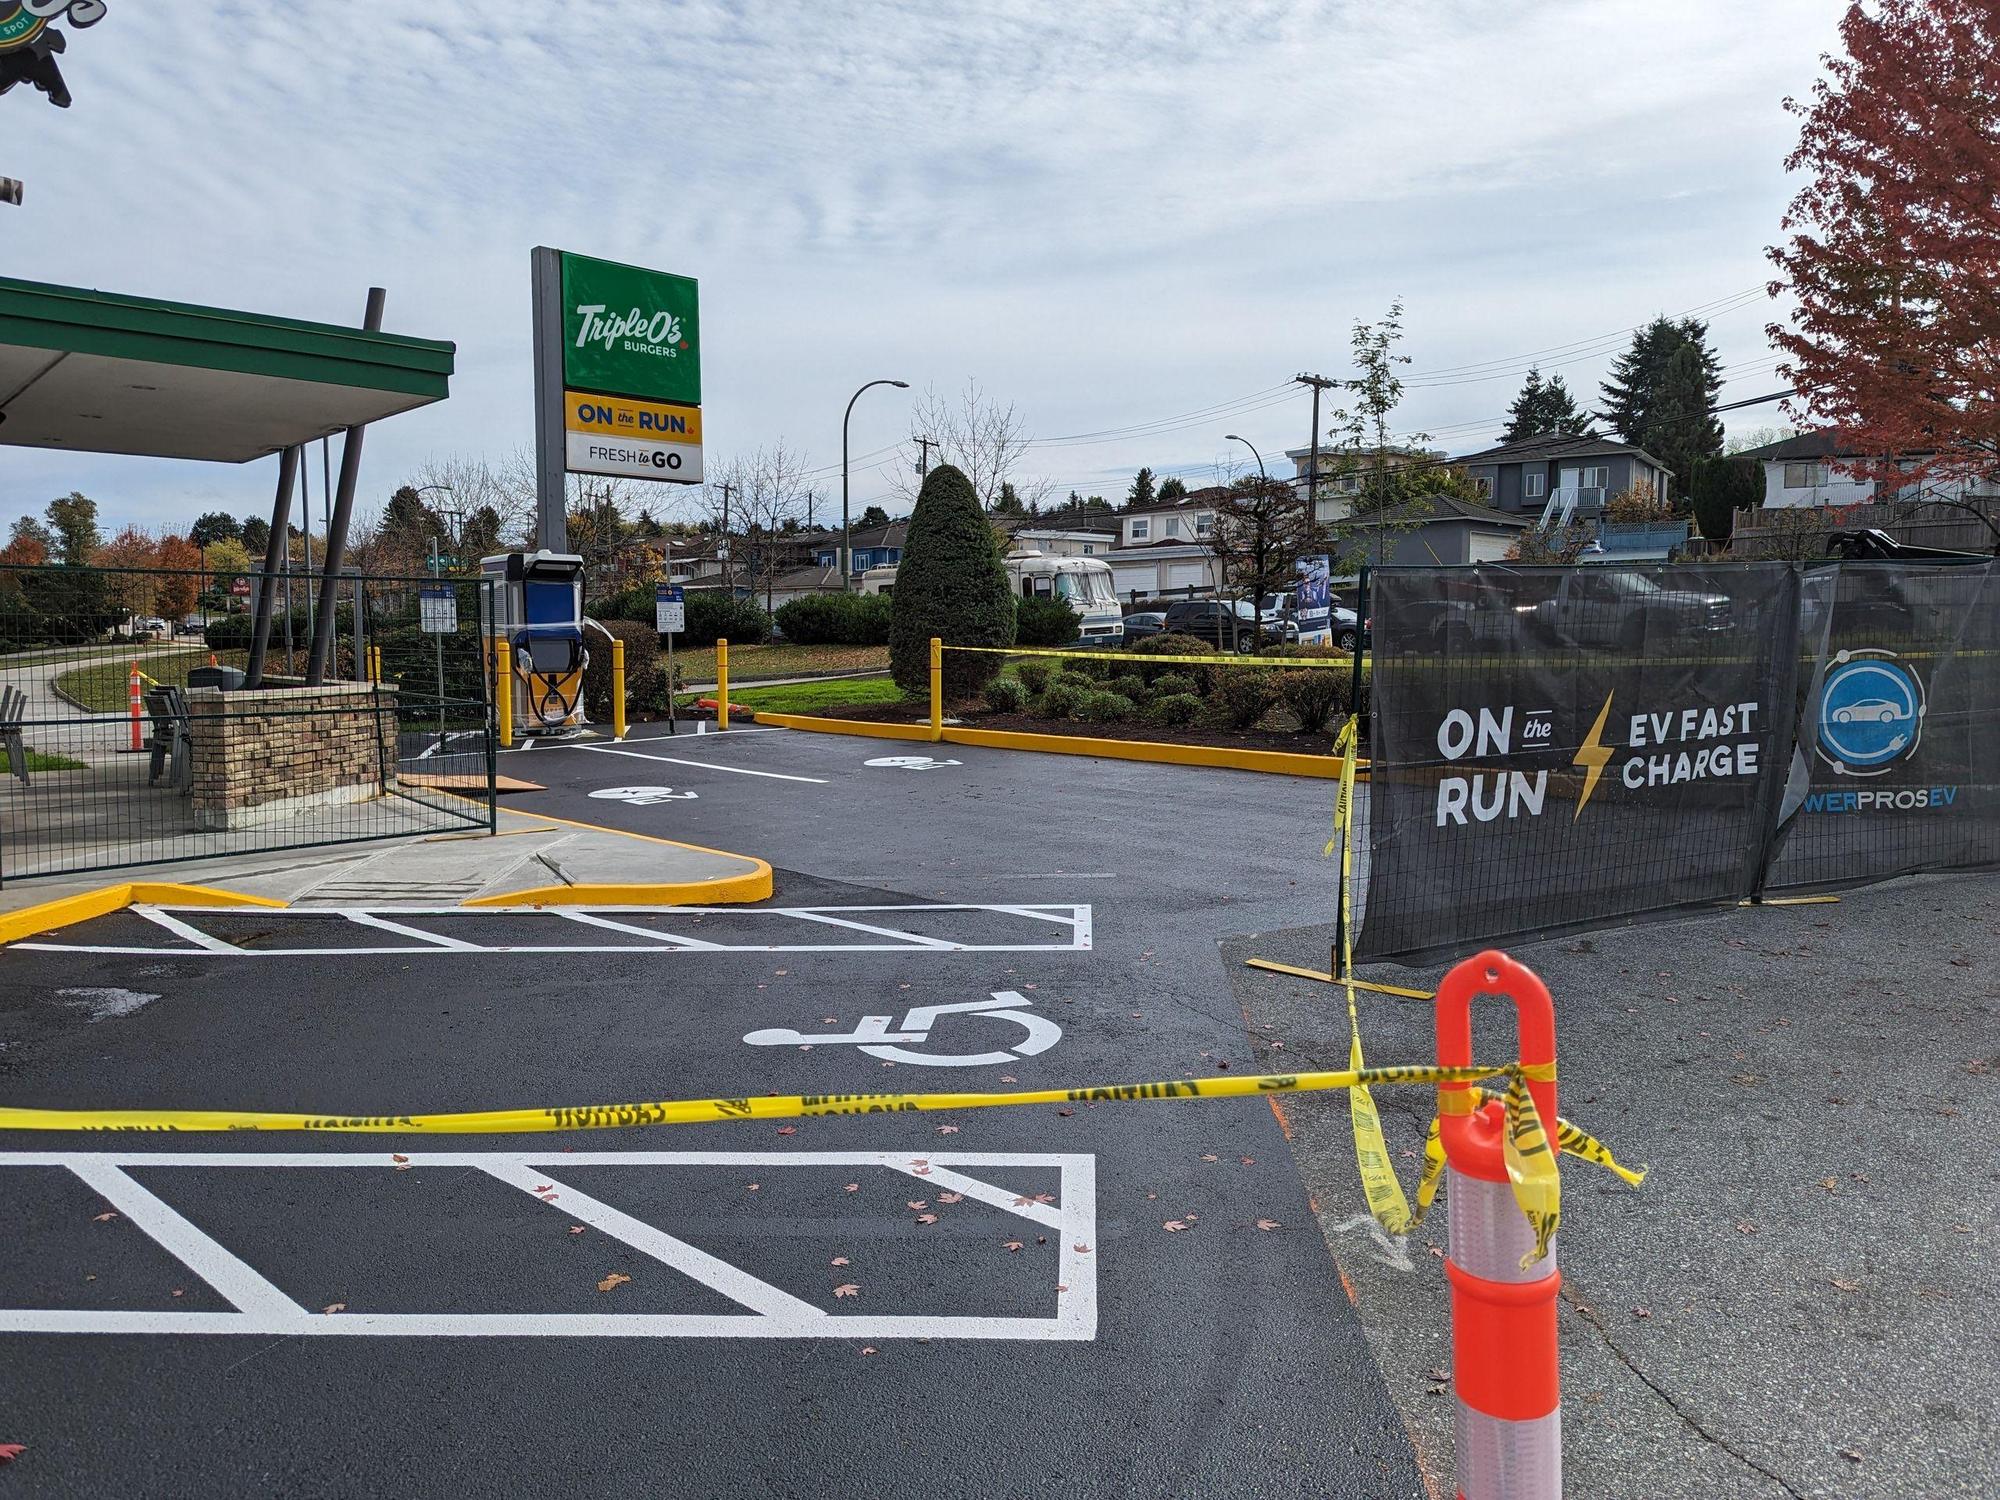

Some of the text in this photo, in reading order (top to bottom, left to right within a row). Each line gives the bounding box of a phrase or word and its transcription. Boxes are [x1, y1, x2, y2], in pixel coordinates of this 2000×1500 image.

[3, 17, 29, 35] SPOT
[624, 340, 677, 358] BURGERS
[578, 404, 685, 434] ON the RUN
[589, 446, 682, 470] FRESH to GO
[1437, 705, 1552, 760] ON the
[1629, 702, 1758, 748] EV FAST
[1622, 743, 1759, 789] CHARGE
[1436, 769, 1548, 827] RUN
